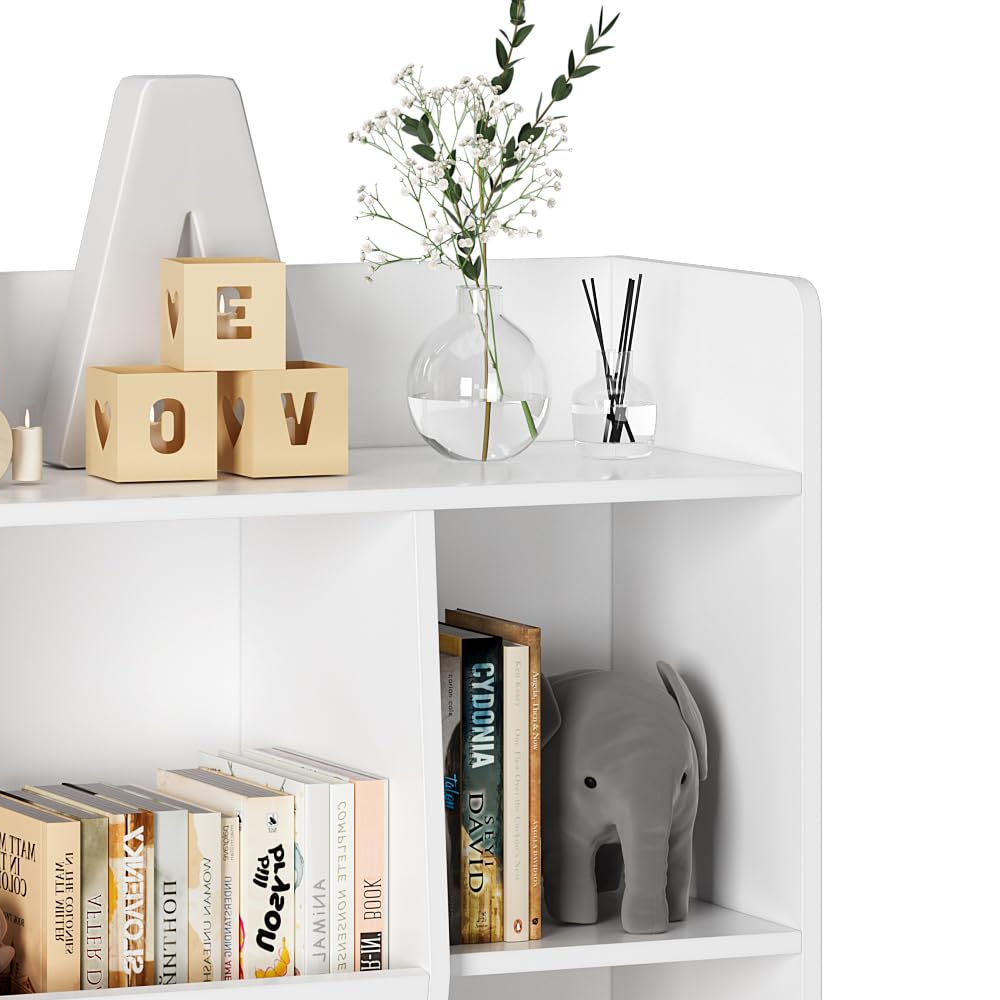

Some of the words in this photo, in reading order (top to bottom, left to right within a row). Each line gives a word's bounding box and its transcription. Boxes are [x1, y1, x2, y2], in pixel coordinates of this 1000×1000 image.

[216, 285, 253, 340] E
[149, 397, 186, 455] O
[280, 391, 318, 446] V
[471, 662, 495, 769] CYDONIA
[531, 732, 540, 751] Now
[468, 791, 484, 893] DAVID
[484, 815, 495, 866] SEYI
